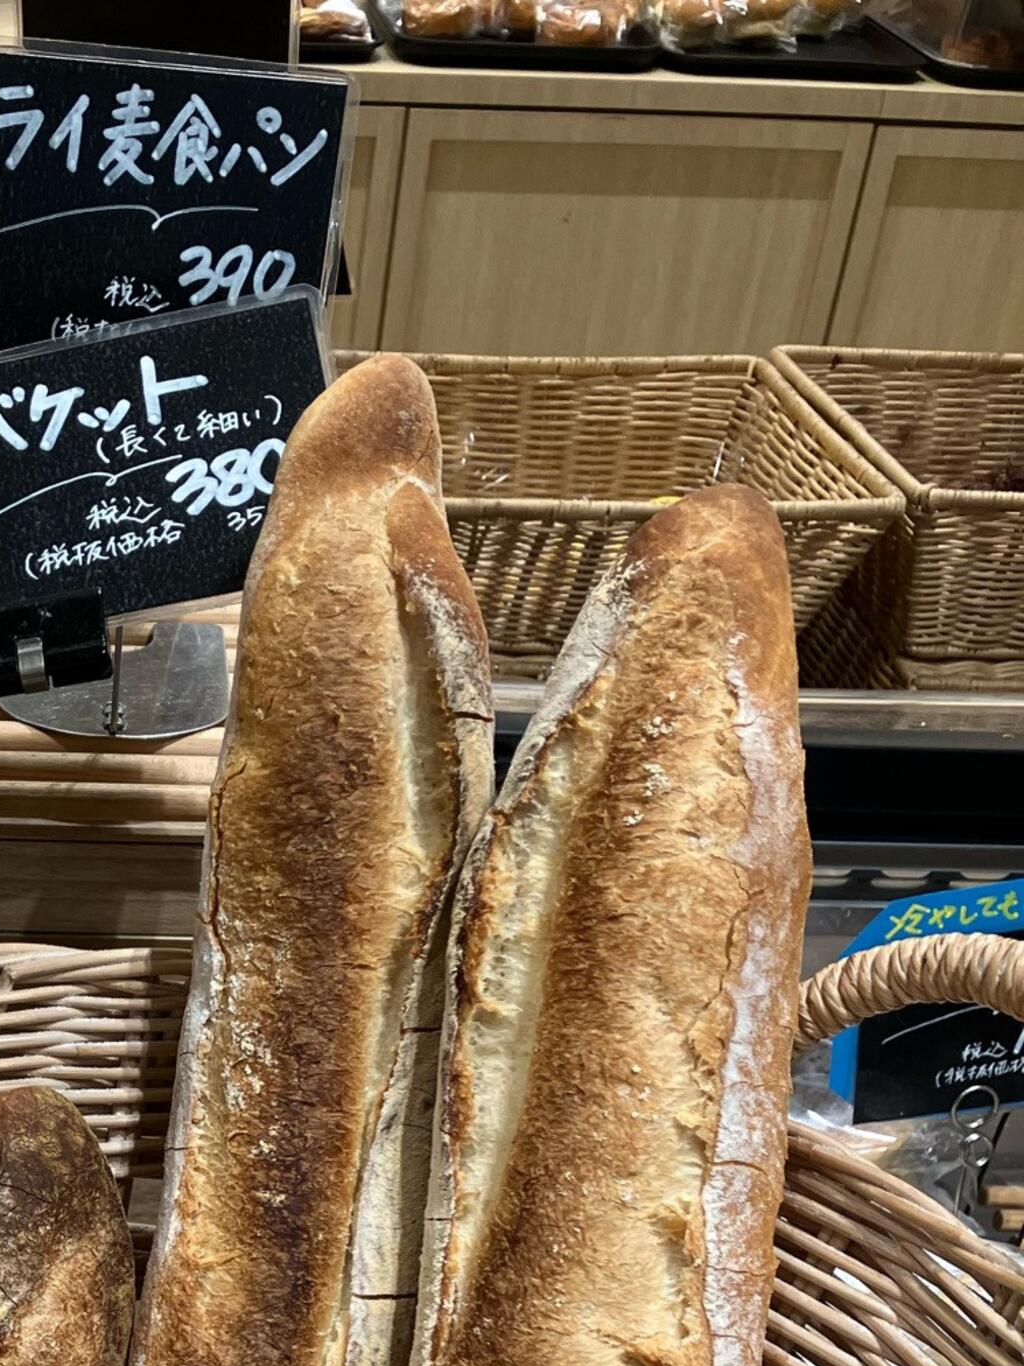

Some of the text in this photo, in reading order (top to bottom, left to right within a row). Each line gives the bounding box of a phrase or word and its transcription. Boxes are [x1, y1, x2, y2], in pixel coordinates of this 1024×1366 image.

[103, 244, 296, 312] 税込 390
[95, 395, 282, 463] (長くて細い)
[86, 438, 286, 530] 税込 380
[25, 520, 185, 580] (税抜価格
[962, 1041, 1007, 1061] 税込
